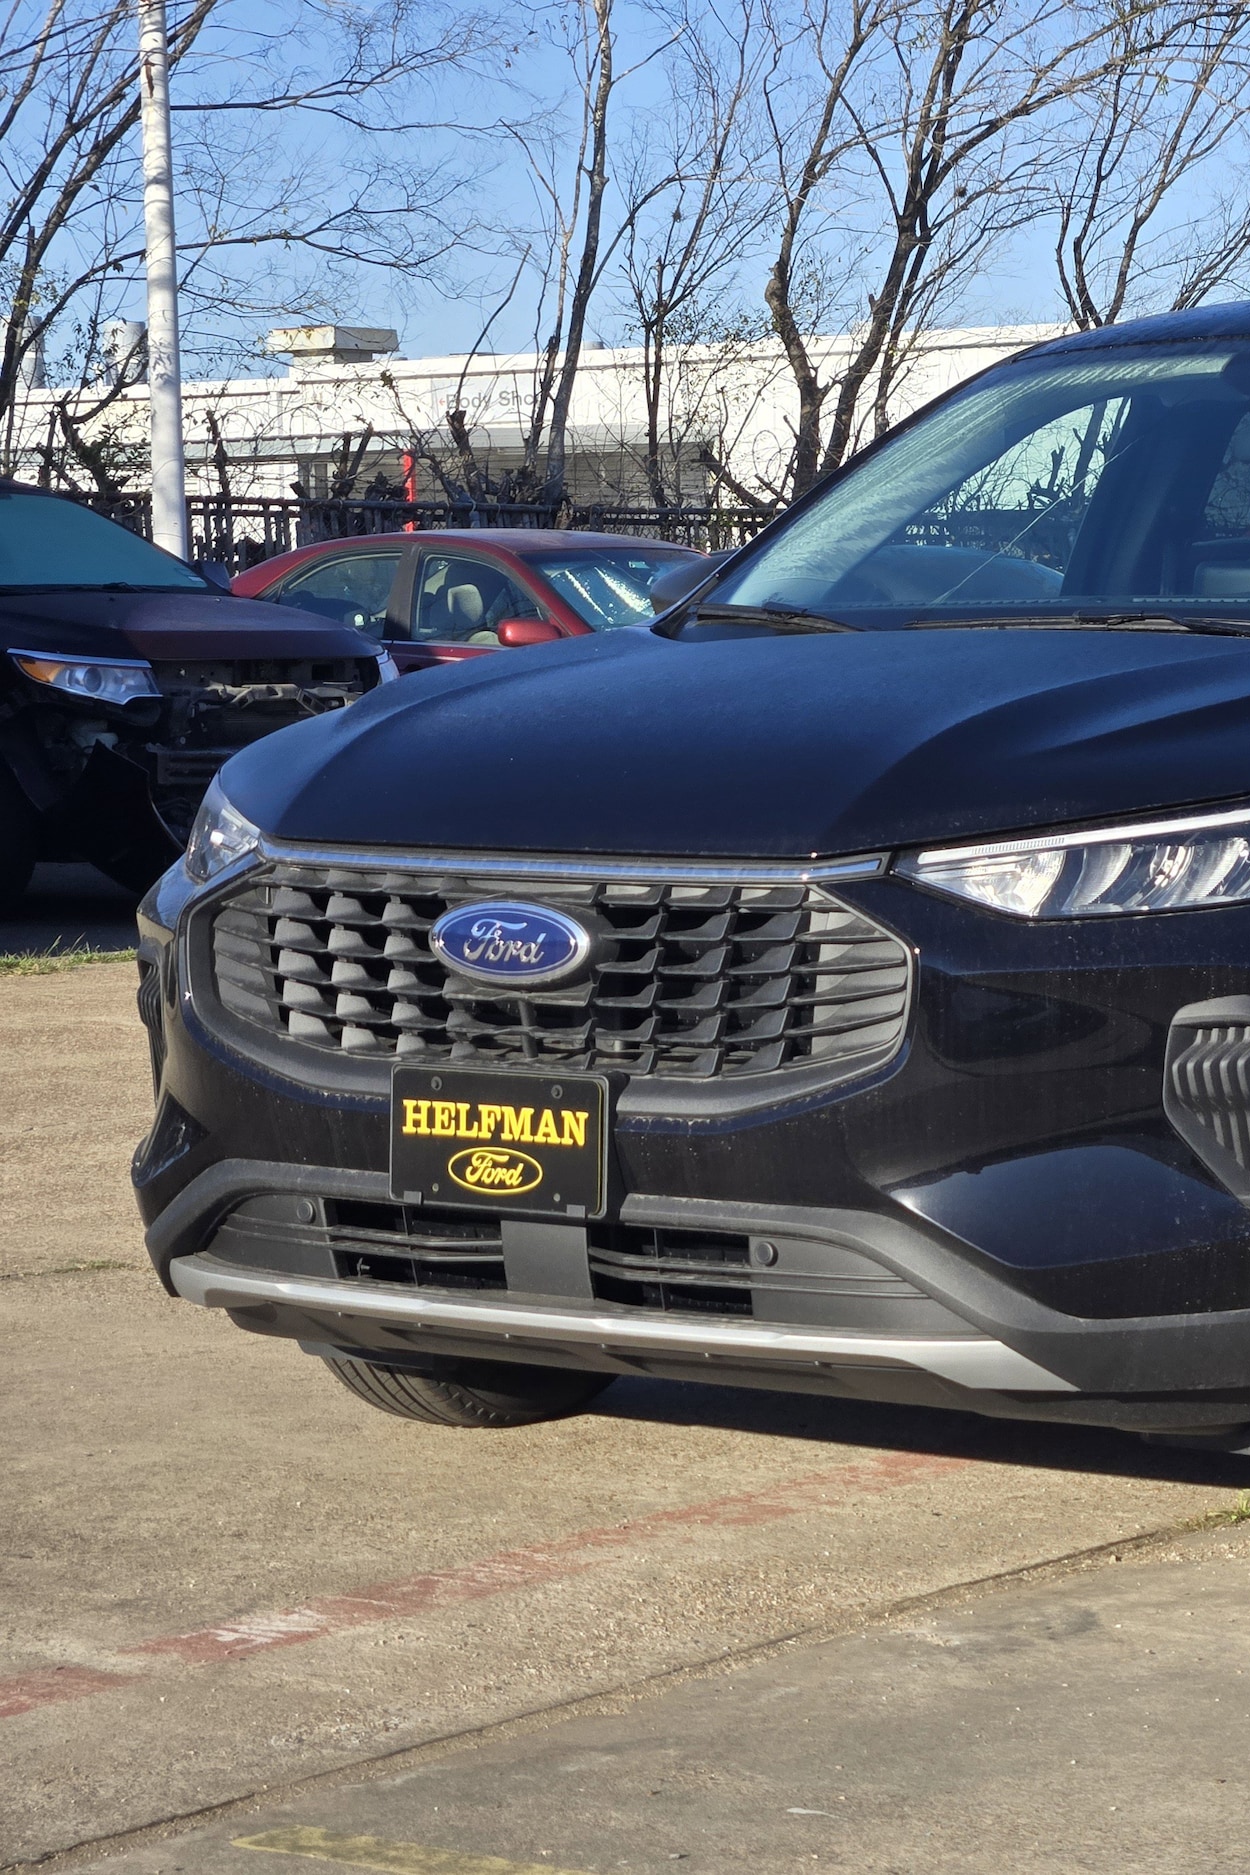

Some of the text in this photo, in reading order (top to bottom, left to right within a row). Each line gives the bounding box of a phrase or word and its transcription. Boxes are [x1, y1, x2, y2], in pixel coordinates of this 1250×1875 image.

[499, 390, 541, 409] Sho
[463, 919, 547, 964] Ford
[402, 1099, 589, 1147] HELFMAN
[465, 1151, 524, 1188] Ford
